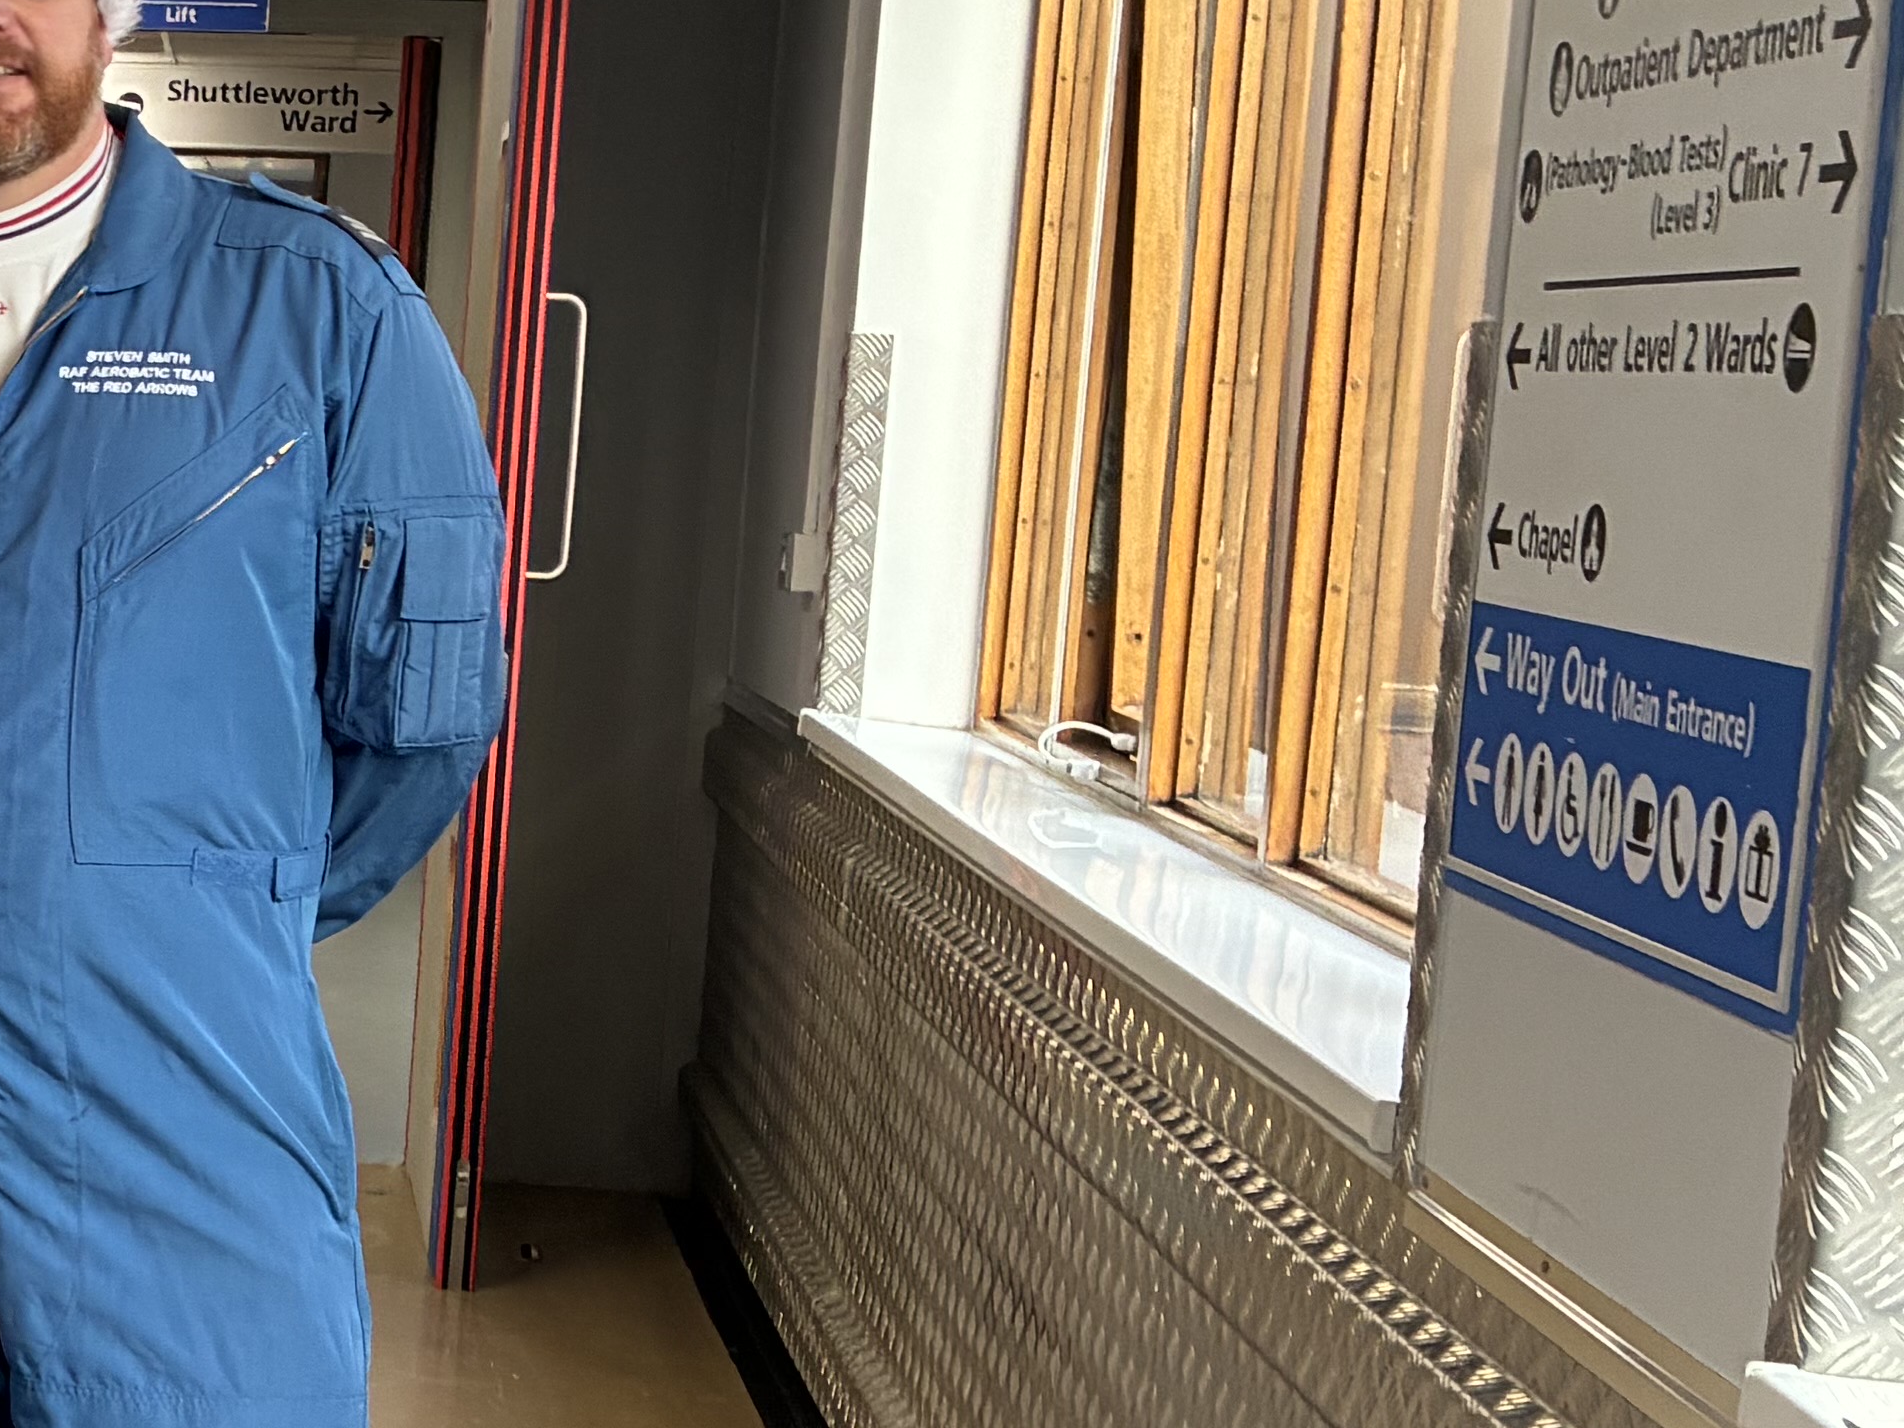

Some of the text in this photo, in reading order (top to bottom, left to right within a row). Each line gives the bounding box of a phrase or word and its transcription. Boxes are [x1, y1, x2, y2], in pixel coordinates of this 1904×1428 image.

[165, 5, 198, 24] Lift
[1575, 3, 1826, 108] Outpatient Department
[167, 79, 359, 106] Shuttleworth
[281, 110, 357, 134] Ward
[1679, 123, 1729, 173] Tests)
[1728, 142, 1814, 204] Clinic 7
[1650, 184, 1722, 241] (Level 3)
[86, 351, 143, 363] STEVEN
[1535, 316, 1779, 375] All other Level 2 Wards
[59, 366, 215, 383] RAF AEROBATIC TEAM
[72, 381, 198, 397] THE RED ARROWS
[1518, 509, 1580, 574] Chapel
[1506, 632, 1756, 758] Way Out (Main Entrance)
